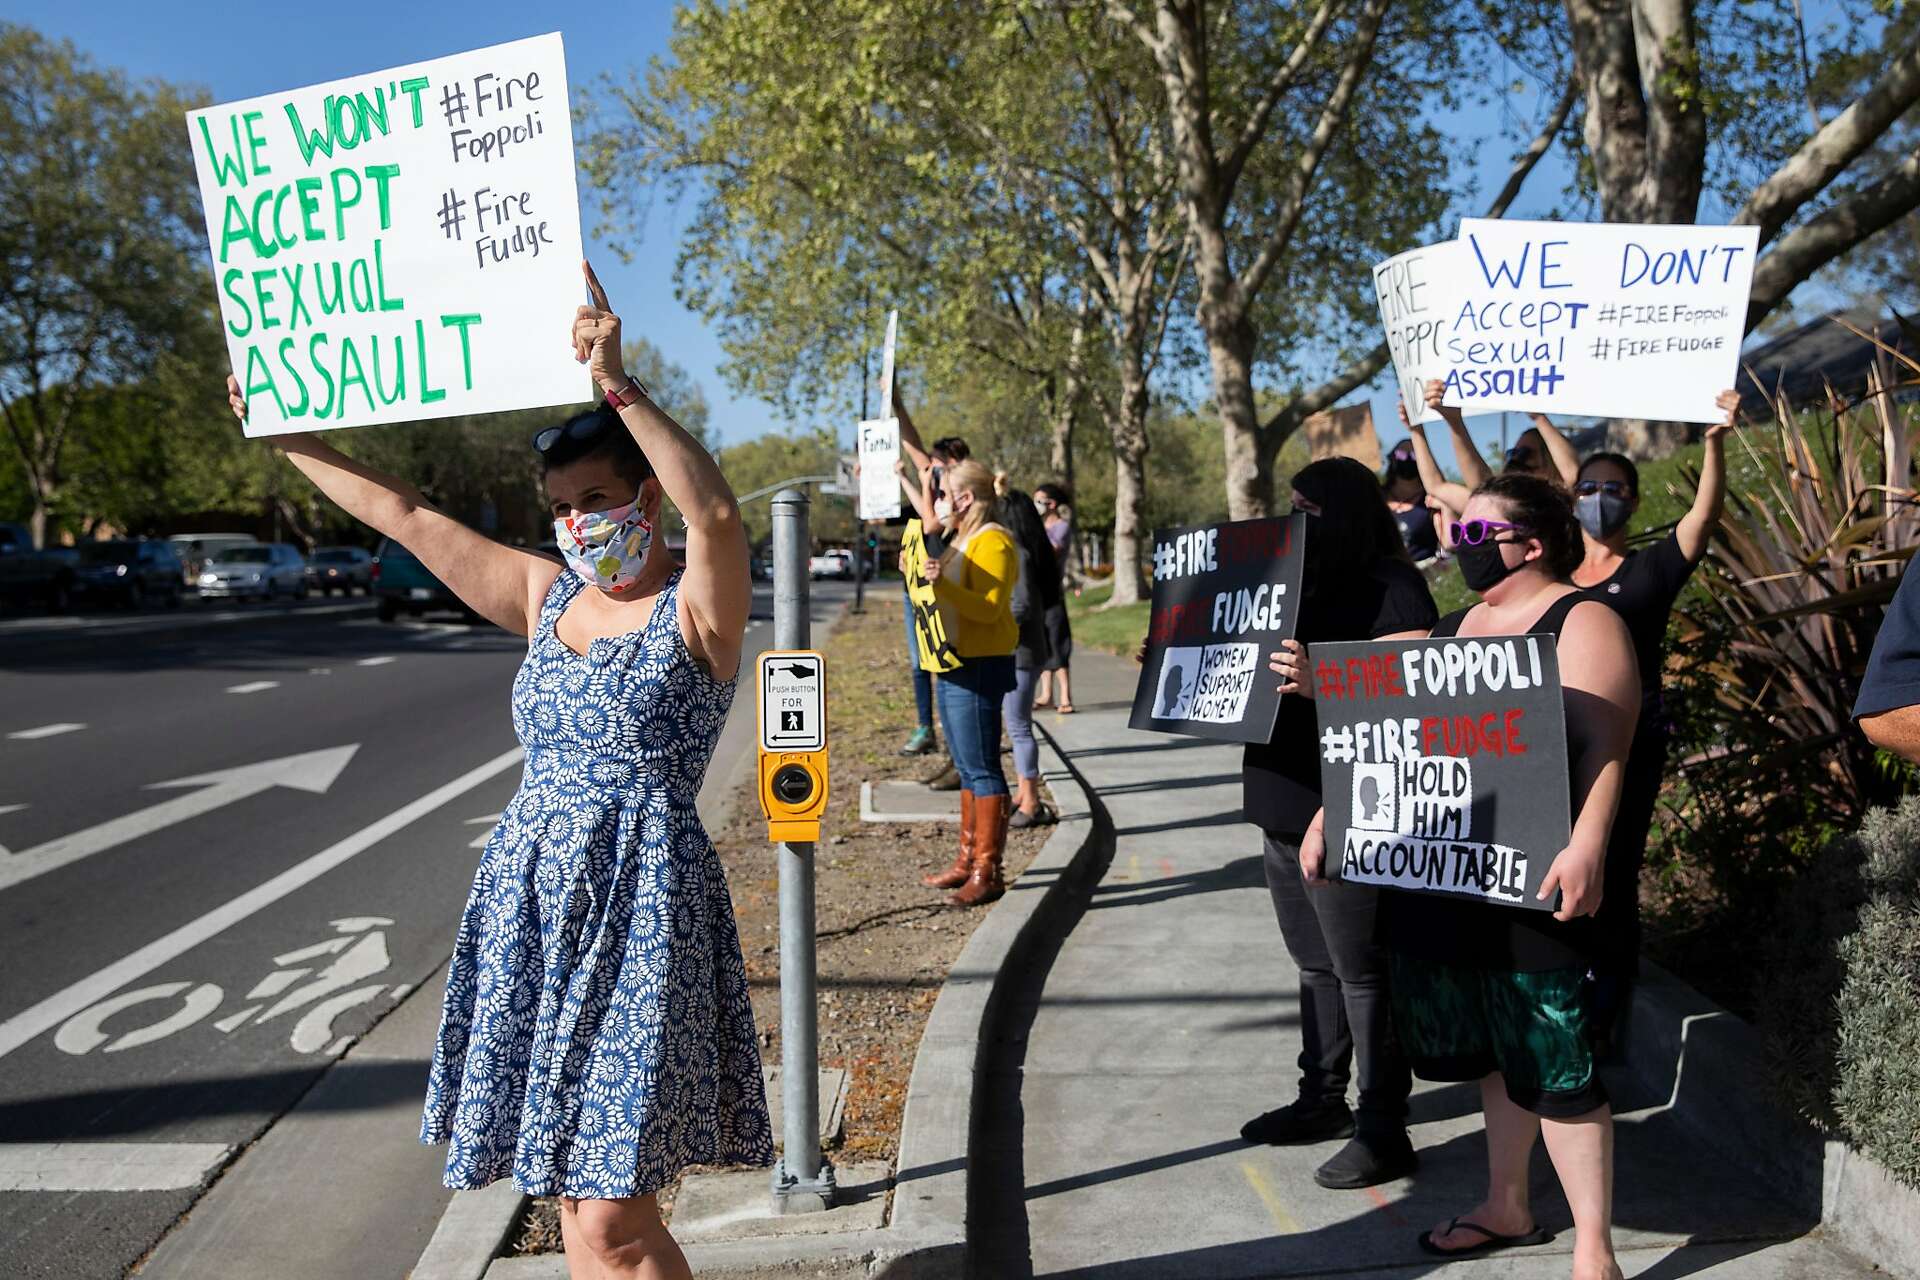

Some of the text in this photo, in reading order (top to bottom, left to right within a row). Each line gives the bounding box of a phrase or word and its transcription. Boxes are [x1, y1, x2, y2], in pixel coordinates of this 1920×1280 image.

[440, 71, 544, 127] #Fire
[198, 76, 429, 188] WE WON'T
[450, 111, 543, 163] Foppoli
[219, 163, 400, 263] ACCEPT
[475, 221, 553, 269] Fudge
[1469, 234, 1744, 289] WE DON'T
[244, 313, 482, 426] ASSAULT
[1200, 669, 1255, 694] SUPPORT
[1204, 647, 1250, 668] WOMEN
[771, 685, 816, 693] PUSH BUTTON
[782, 698, 803, 707] FOR
[1191, 697, 1239, 719] WOMEN
[1403, 760, 1467, 798] HOLD
[1412, 801, 1462, 838] HIM
[1343, 838, 1527, 897] ACCOUNTABLE
